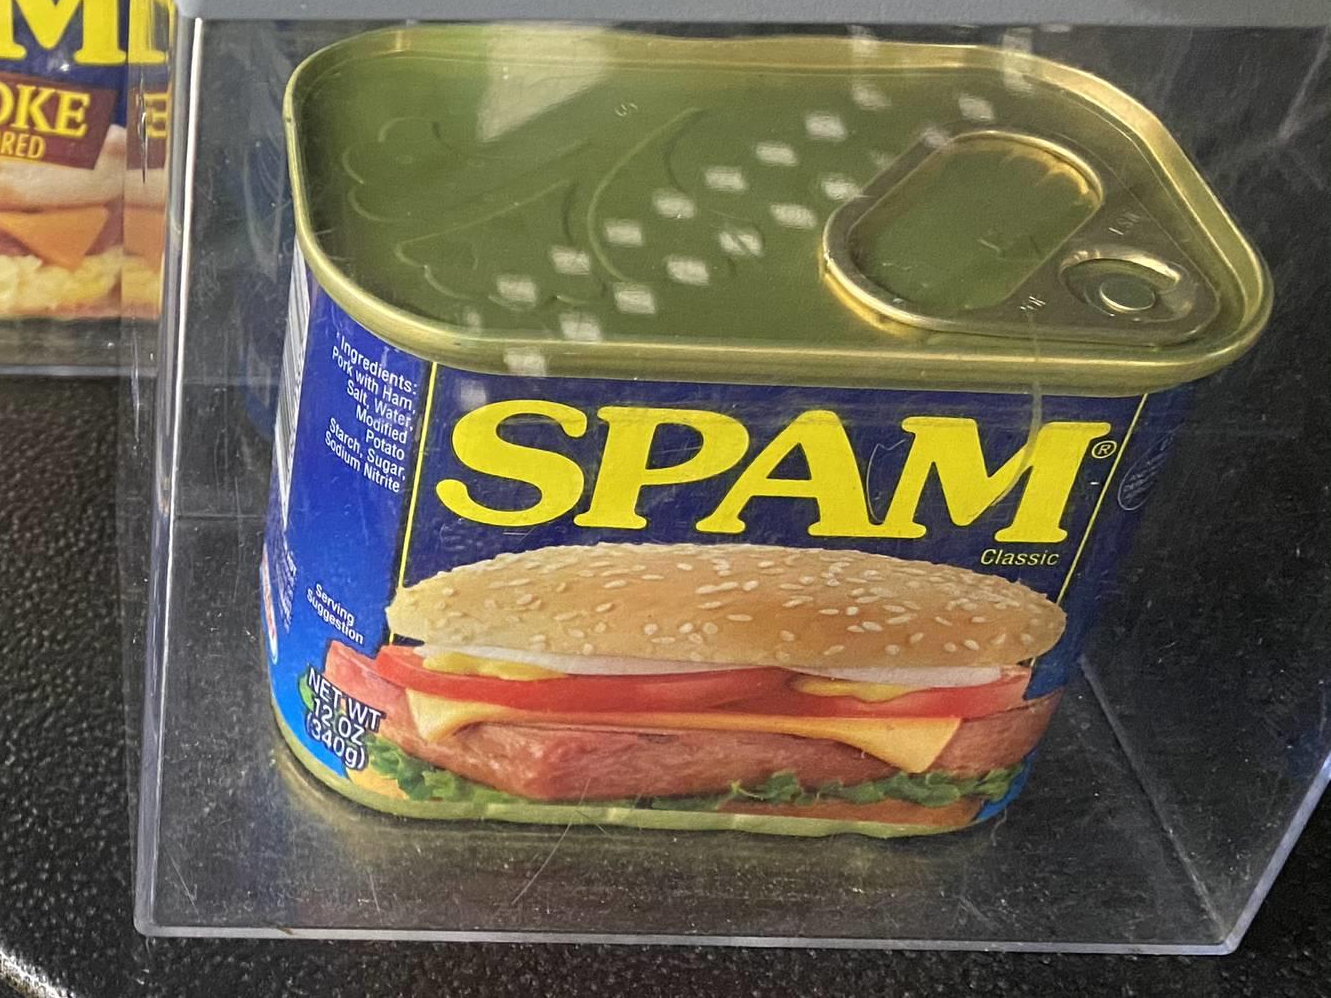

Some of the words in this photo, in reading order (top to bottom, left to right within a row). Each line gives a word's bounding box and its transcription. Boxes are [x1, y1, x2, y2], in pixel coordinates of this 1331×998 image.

[332, 345, 353, 377] Pork
[356, 369, 378, 395] with
[382, 389, 416, 414] Ham,
[341, 335, 417, 395] Ingredients:
[346, 379, 370, 409] Salt,
[374, 398, 413, 431] Water,
[355, 404, 408, 444] Modified
[324, 431, 360, 472] Sodium
[363, 462, 400, 493] Nitrite
[329, 417, 363, 459] Starch,
[367, 448, 406, 480] Sugar,
[365, 429, 405, 461] Potato
[980, 548, 1059, 566] Classic
[306, 588, 364, 645] Suggestion
[315, 583, 354, 627] Serving
[308, 667, 342, 709] NET
[348, 697, 382, 731] WT
[313, 697, 333, 728] 12
[338, 718, 365, 746] OZ
[306, 713, 366, 770] (340g)
